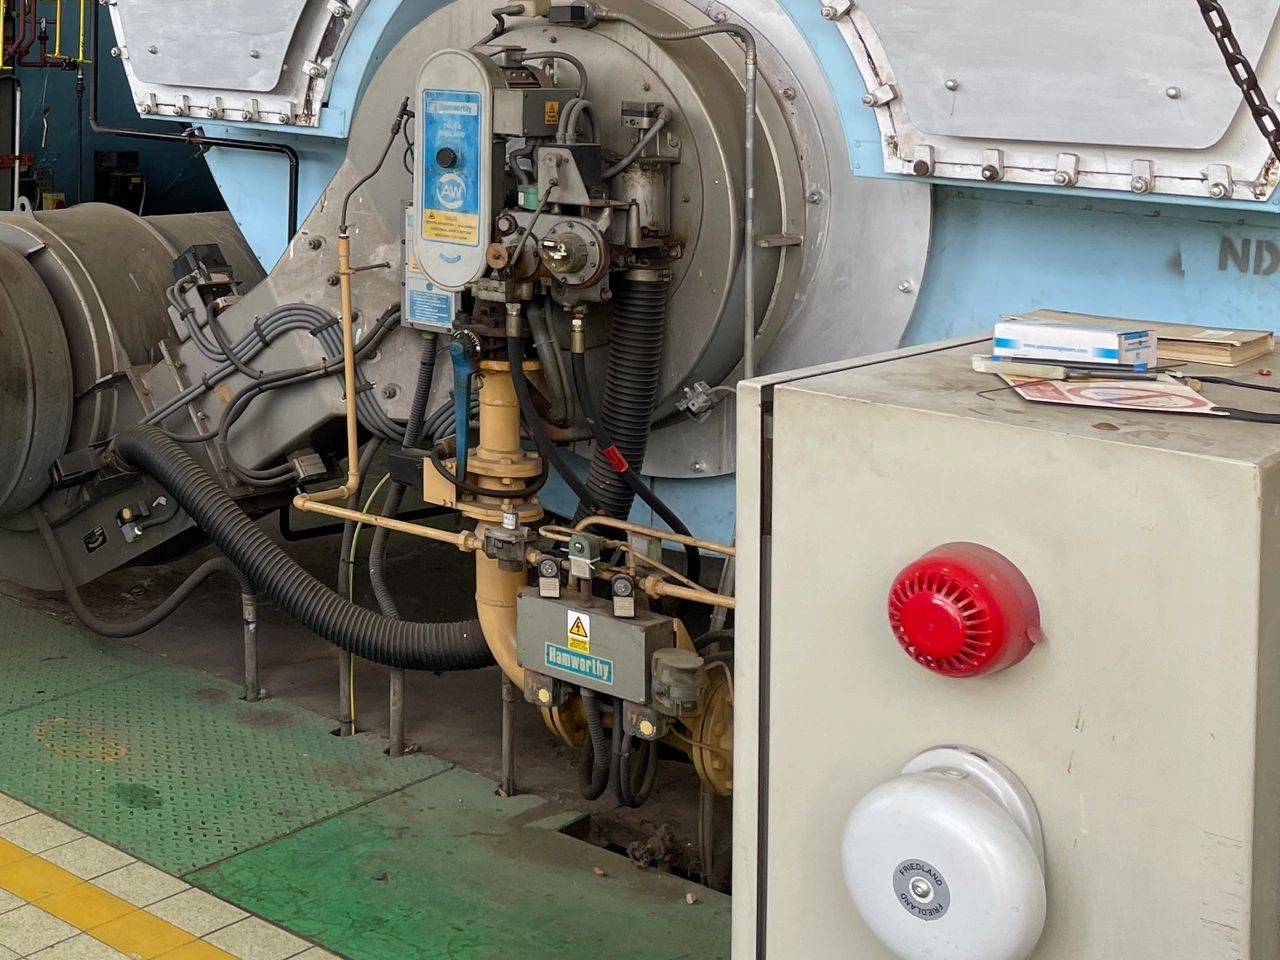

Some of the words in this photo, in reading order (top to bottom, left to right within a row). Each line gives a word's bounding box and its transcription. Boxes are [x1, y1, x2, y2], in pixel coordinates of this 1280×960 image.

[440, 184, 462, 198] AW
[1218, 235, 1280, 276] ND
[549, 646, 609, 680] Hamworthy
[899, 862, 943, 886] FRIEDLAND
[900, 892, 944, 917] FRIEDLAND
